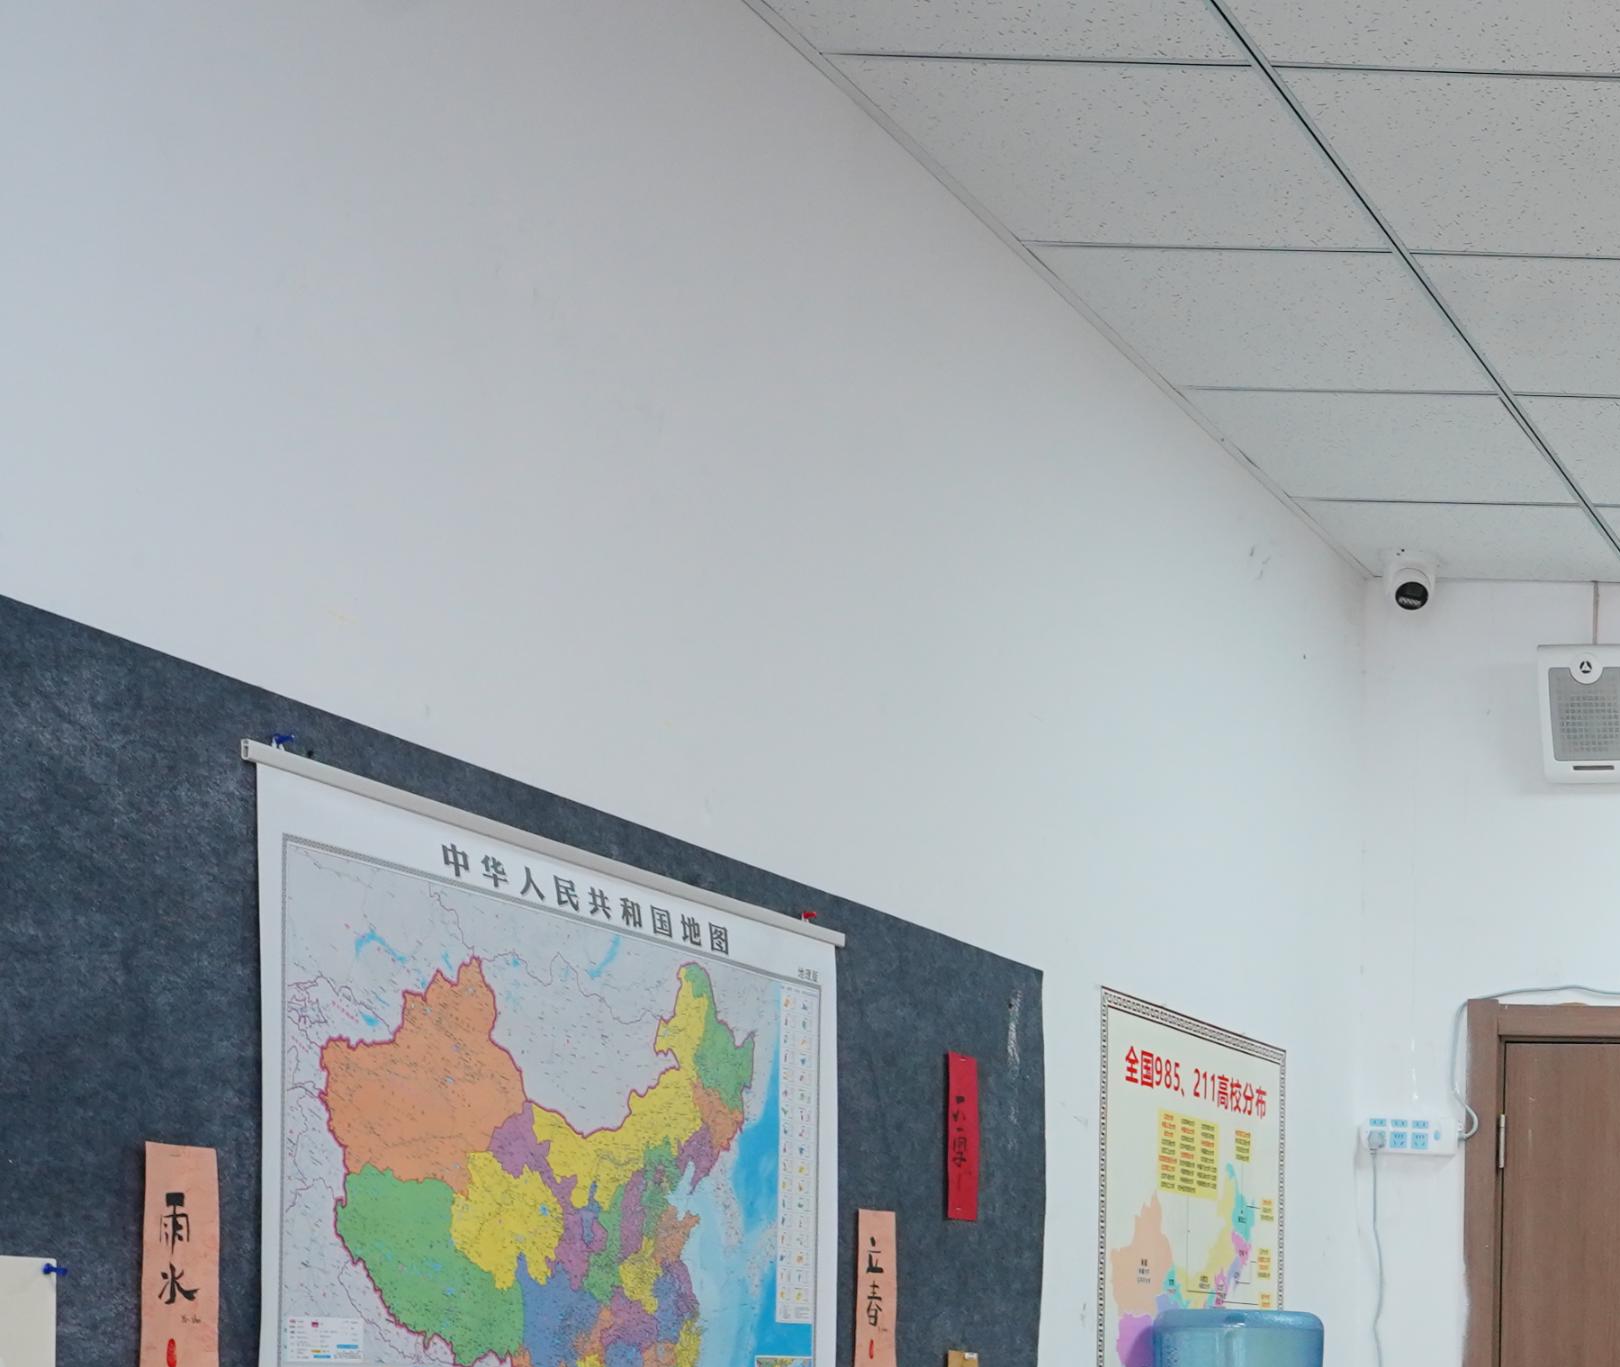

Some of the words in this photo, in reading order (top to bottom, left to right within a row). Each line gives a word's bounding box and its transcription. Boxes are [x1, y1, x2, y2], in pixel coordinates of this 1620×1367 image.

[441, 842, 730, 956] 中华人民共和国地图
[1124, 1045, 1267, 1119] 全国985、211高校分布
[157, 1191, 201, 1306] 雨水
[866, 1236, 885, 1328] 立春
